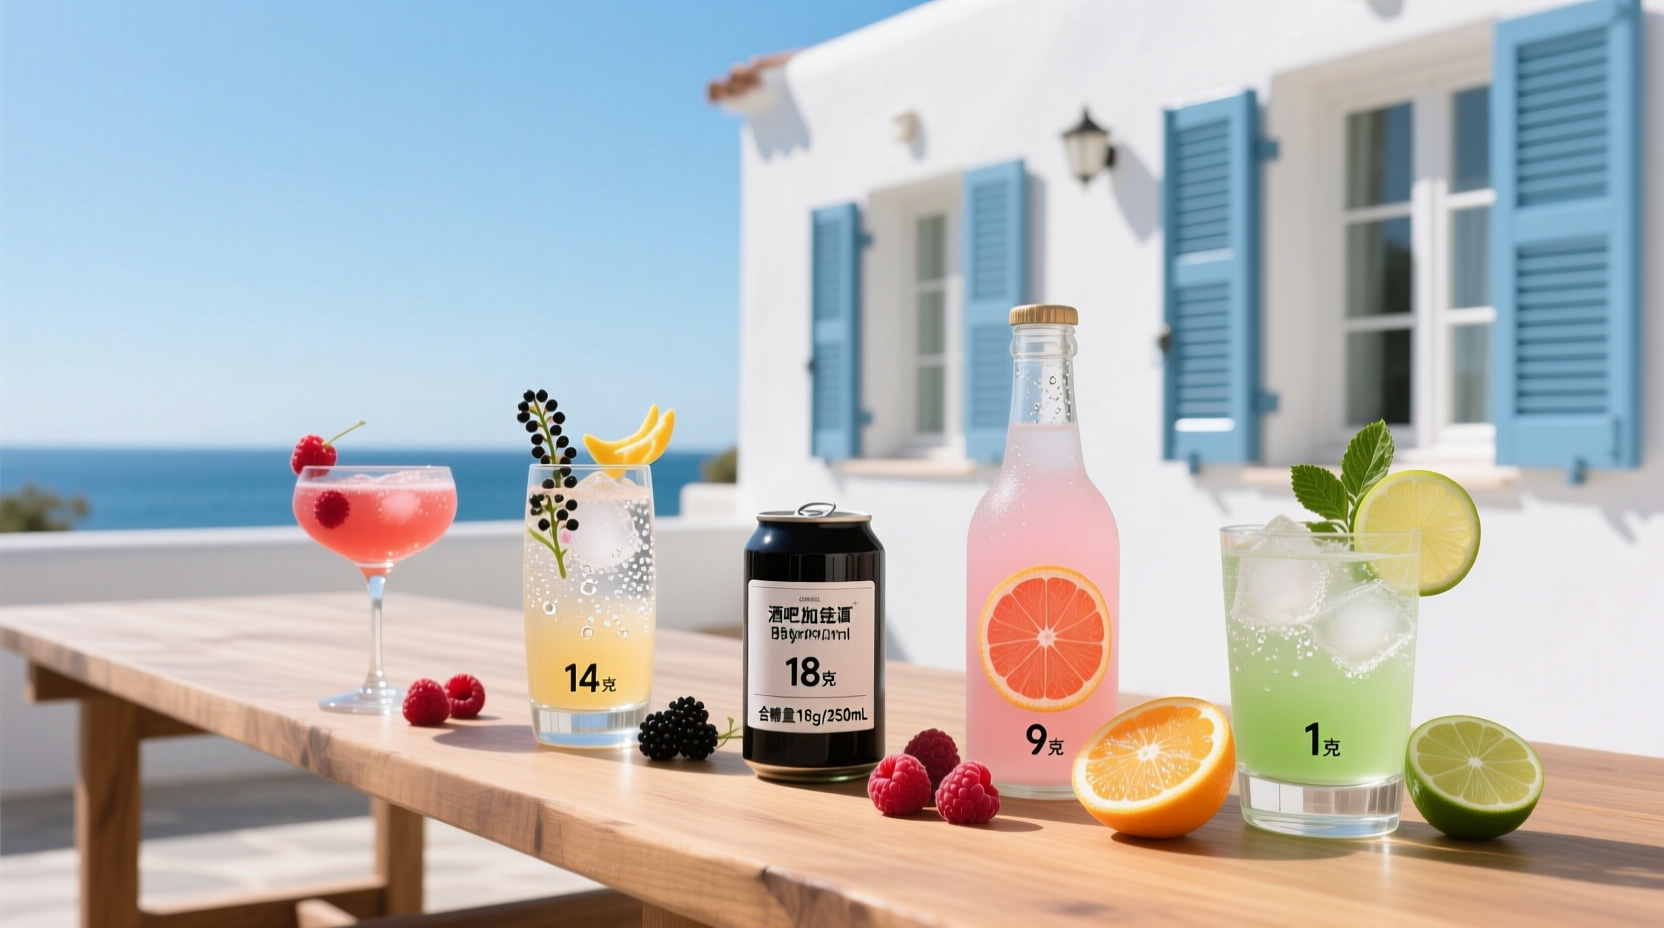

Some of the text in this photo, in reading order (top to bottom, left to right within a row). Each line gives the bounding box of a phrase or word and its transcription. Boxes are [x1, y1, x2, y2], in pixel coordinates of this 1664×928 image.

[565, 663, 616, 692] 14克
[785, 656, 836, 687] 18克
[1026, 723, 1064, 755] 9克
[1305, 722, 1340, 756] 1克
